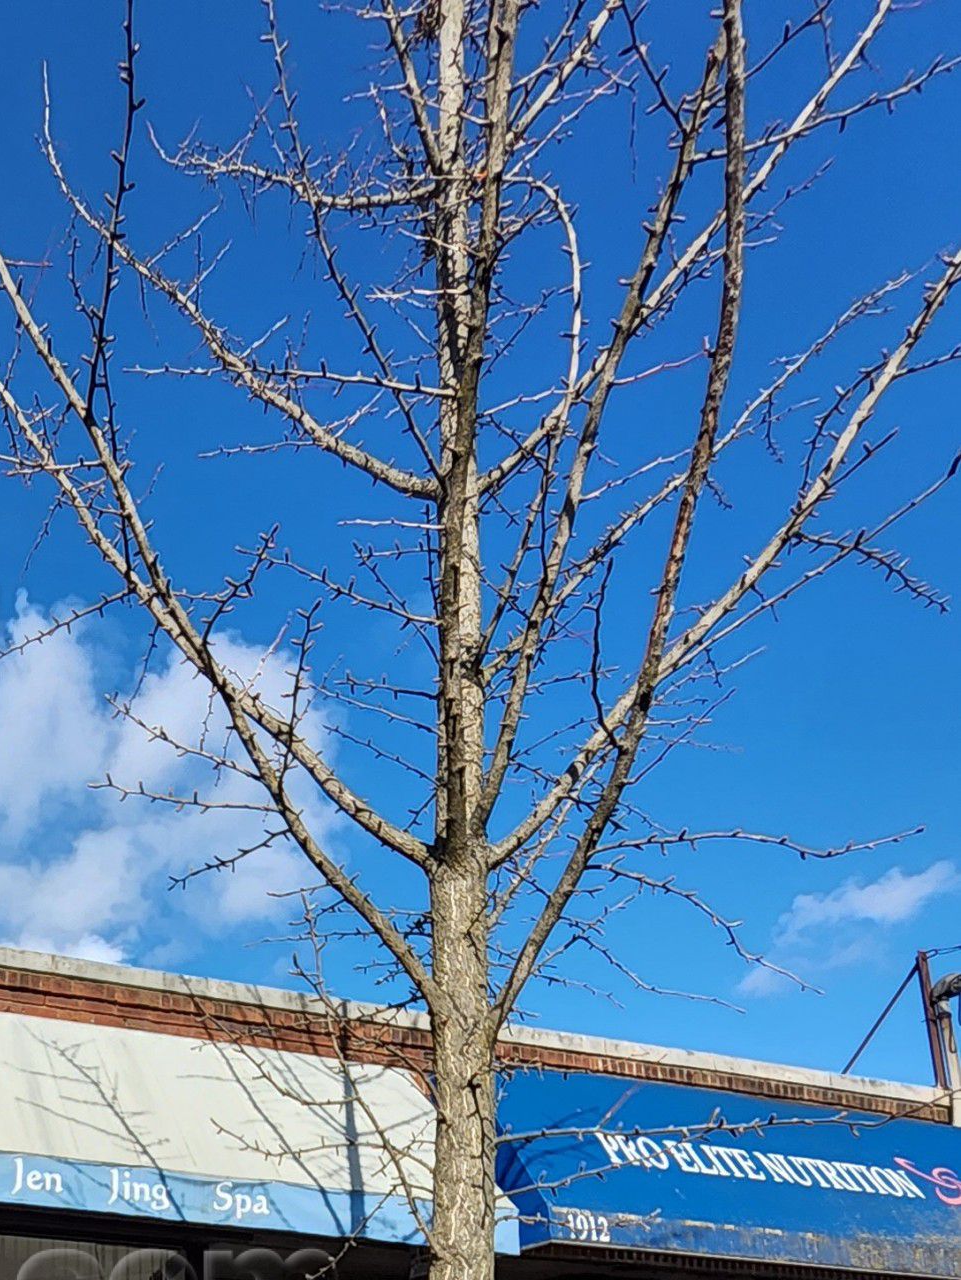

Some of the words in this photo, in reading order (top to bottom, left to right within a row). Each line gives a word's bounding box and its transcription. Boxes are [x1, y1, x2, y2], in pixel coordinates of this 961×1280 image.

[11, 1157, 63, 1195] Jen
[108, 1167, 170, 1211] Jing
[213, 1181, 270, 1218] Spa
[594, 1132, 670, 1170] PRO
[662, 1139, 766, 1181] ELITE
[752, 1151, 926, 1200] NUTRITION
[567, 1212, 611, 1242] 1912
